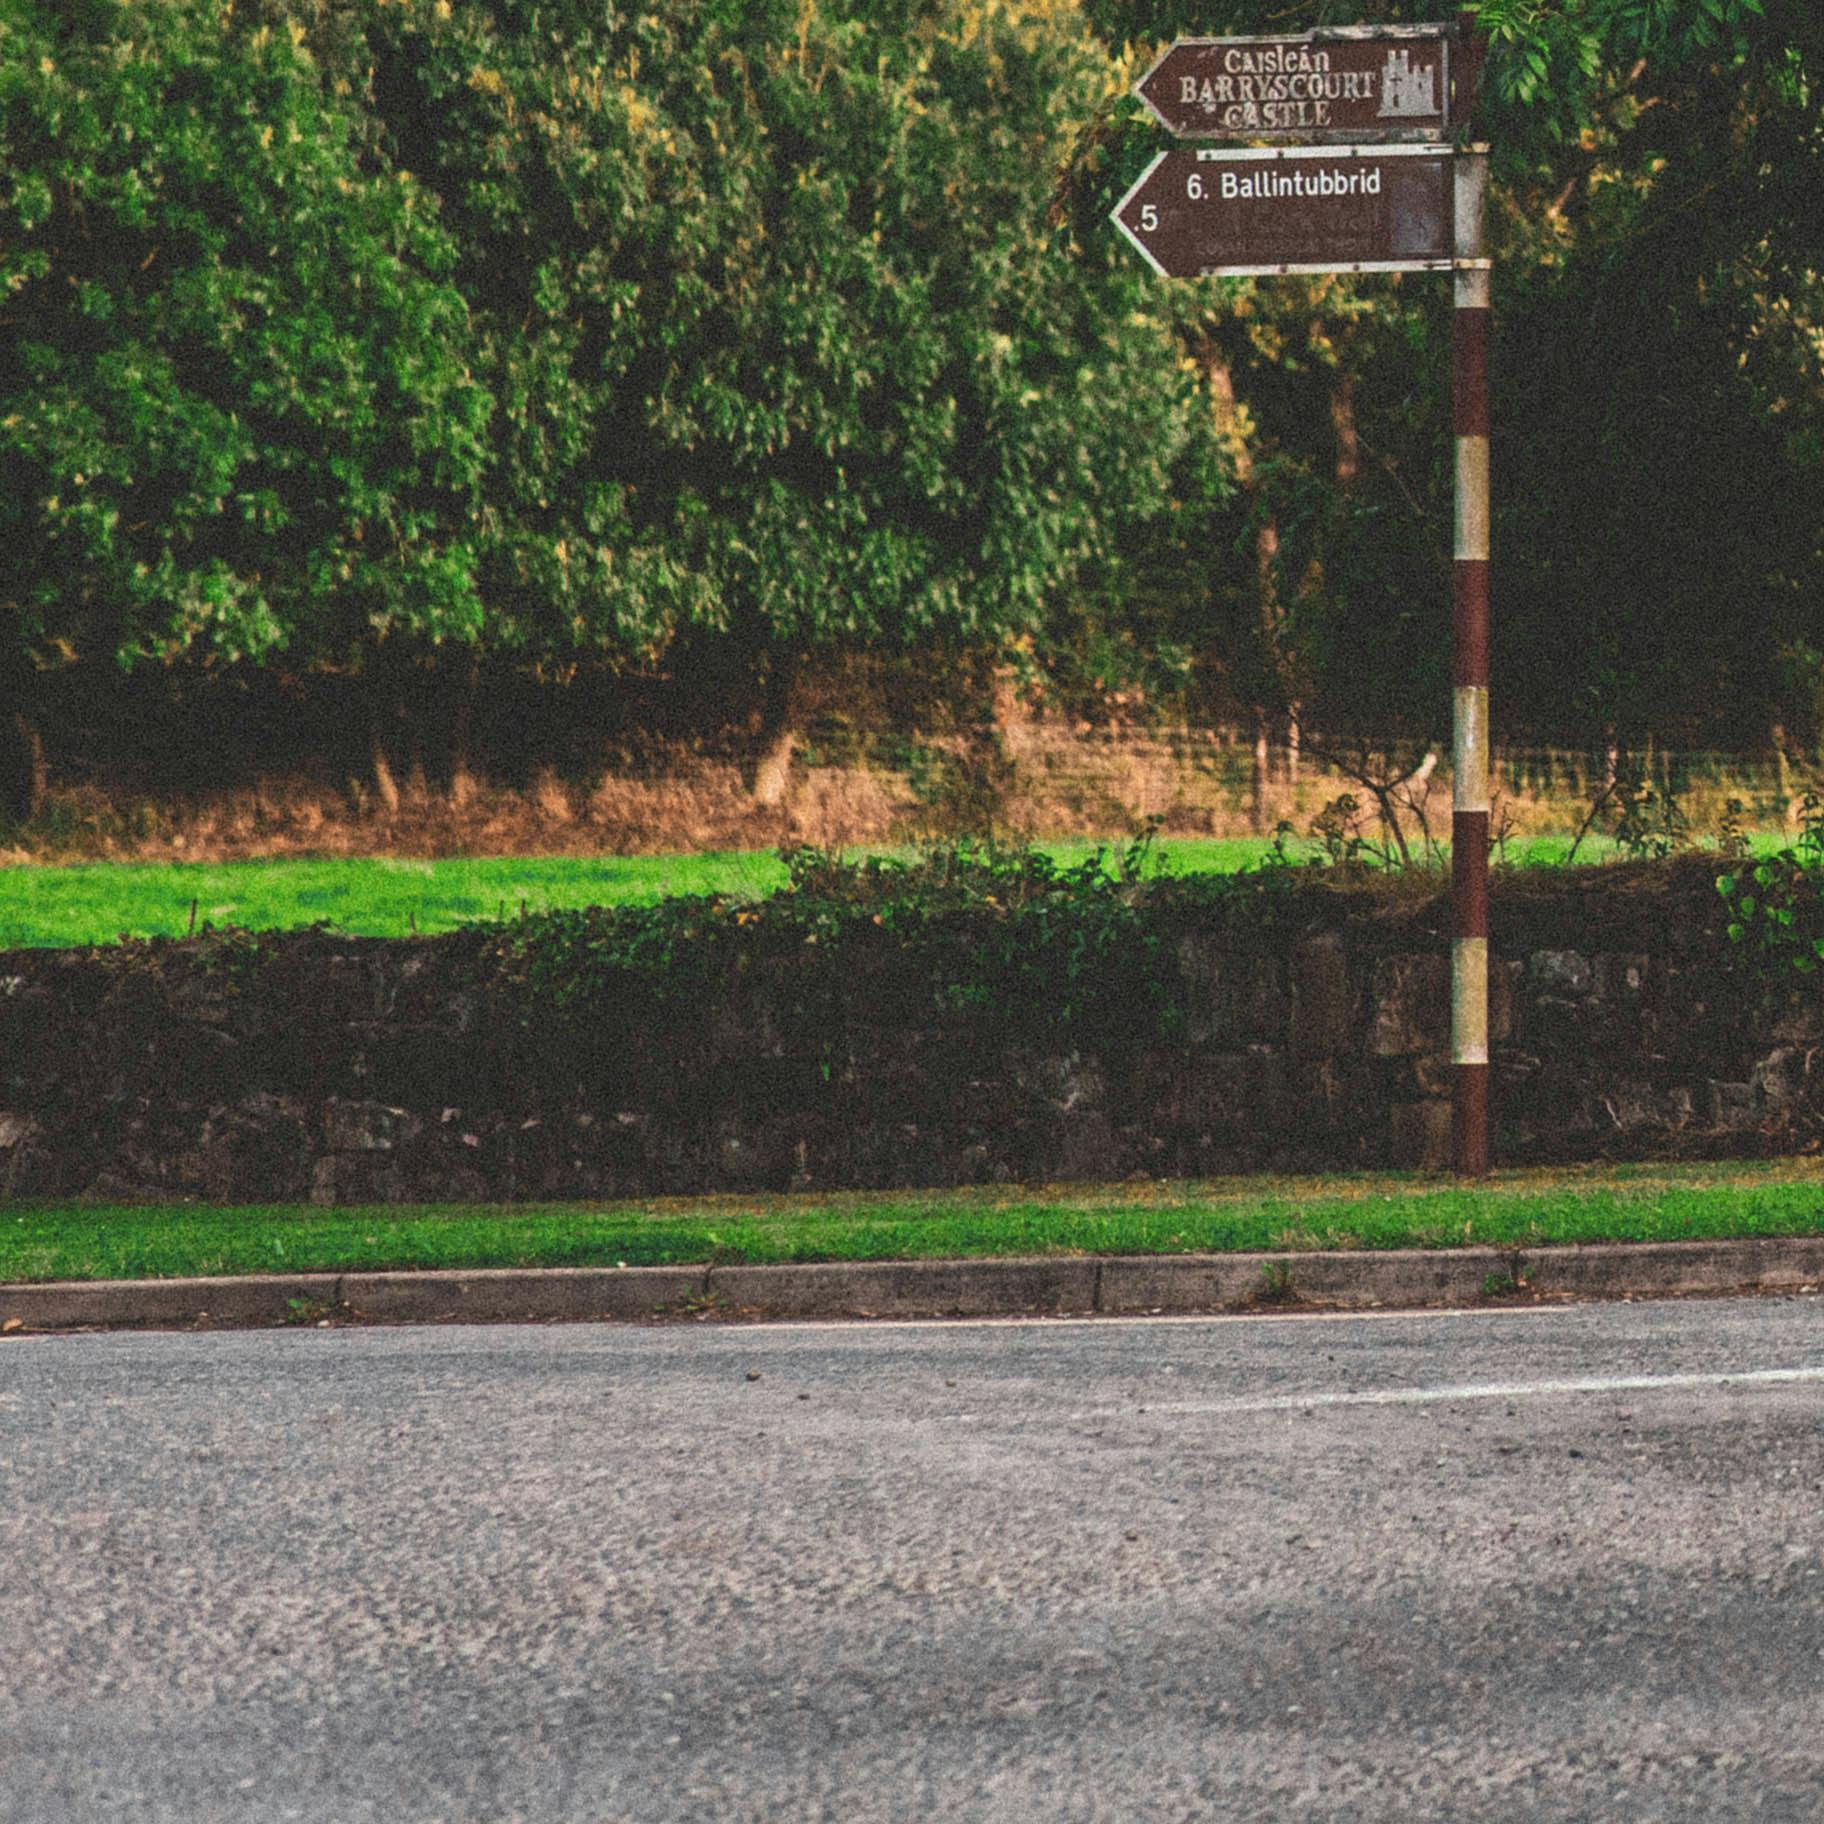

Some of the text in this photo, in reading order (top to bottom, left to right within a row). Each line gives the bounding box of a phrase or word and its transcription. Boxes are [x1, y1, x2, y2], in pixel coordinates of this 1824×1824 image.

[1179, 72, 1377, 104] BARRYSCOURT
[1224, 101, 1332, 130] CASTLE
[1187, 168, 1382, 200] 6. Ballintubbrid
